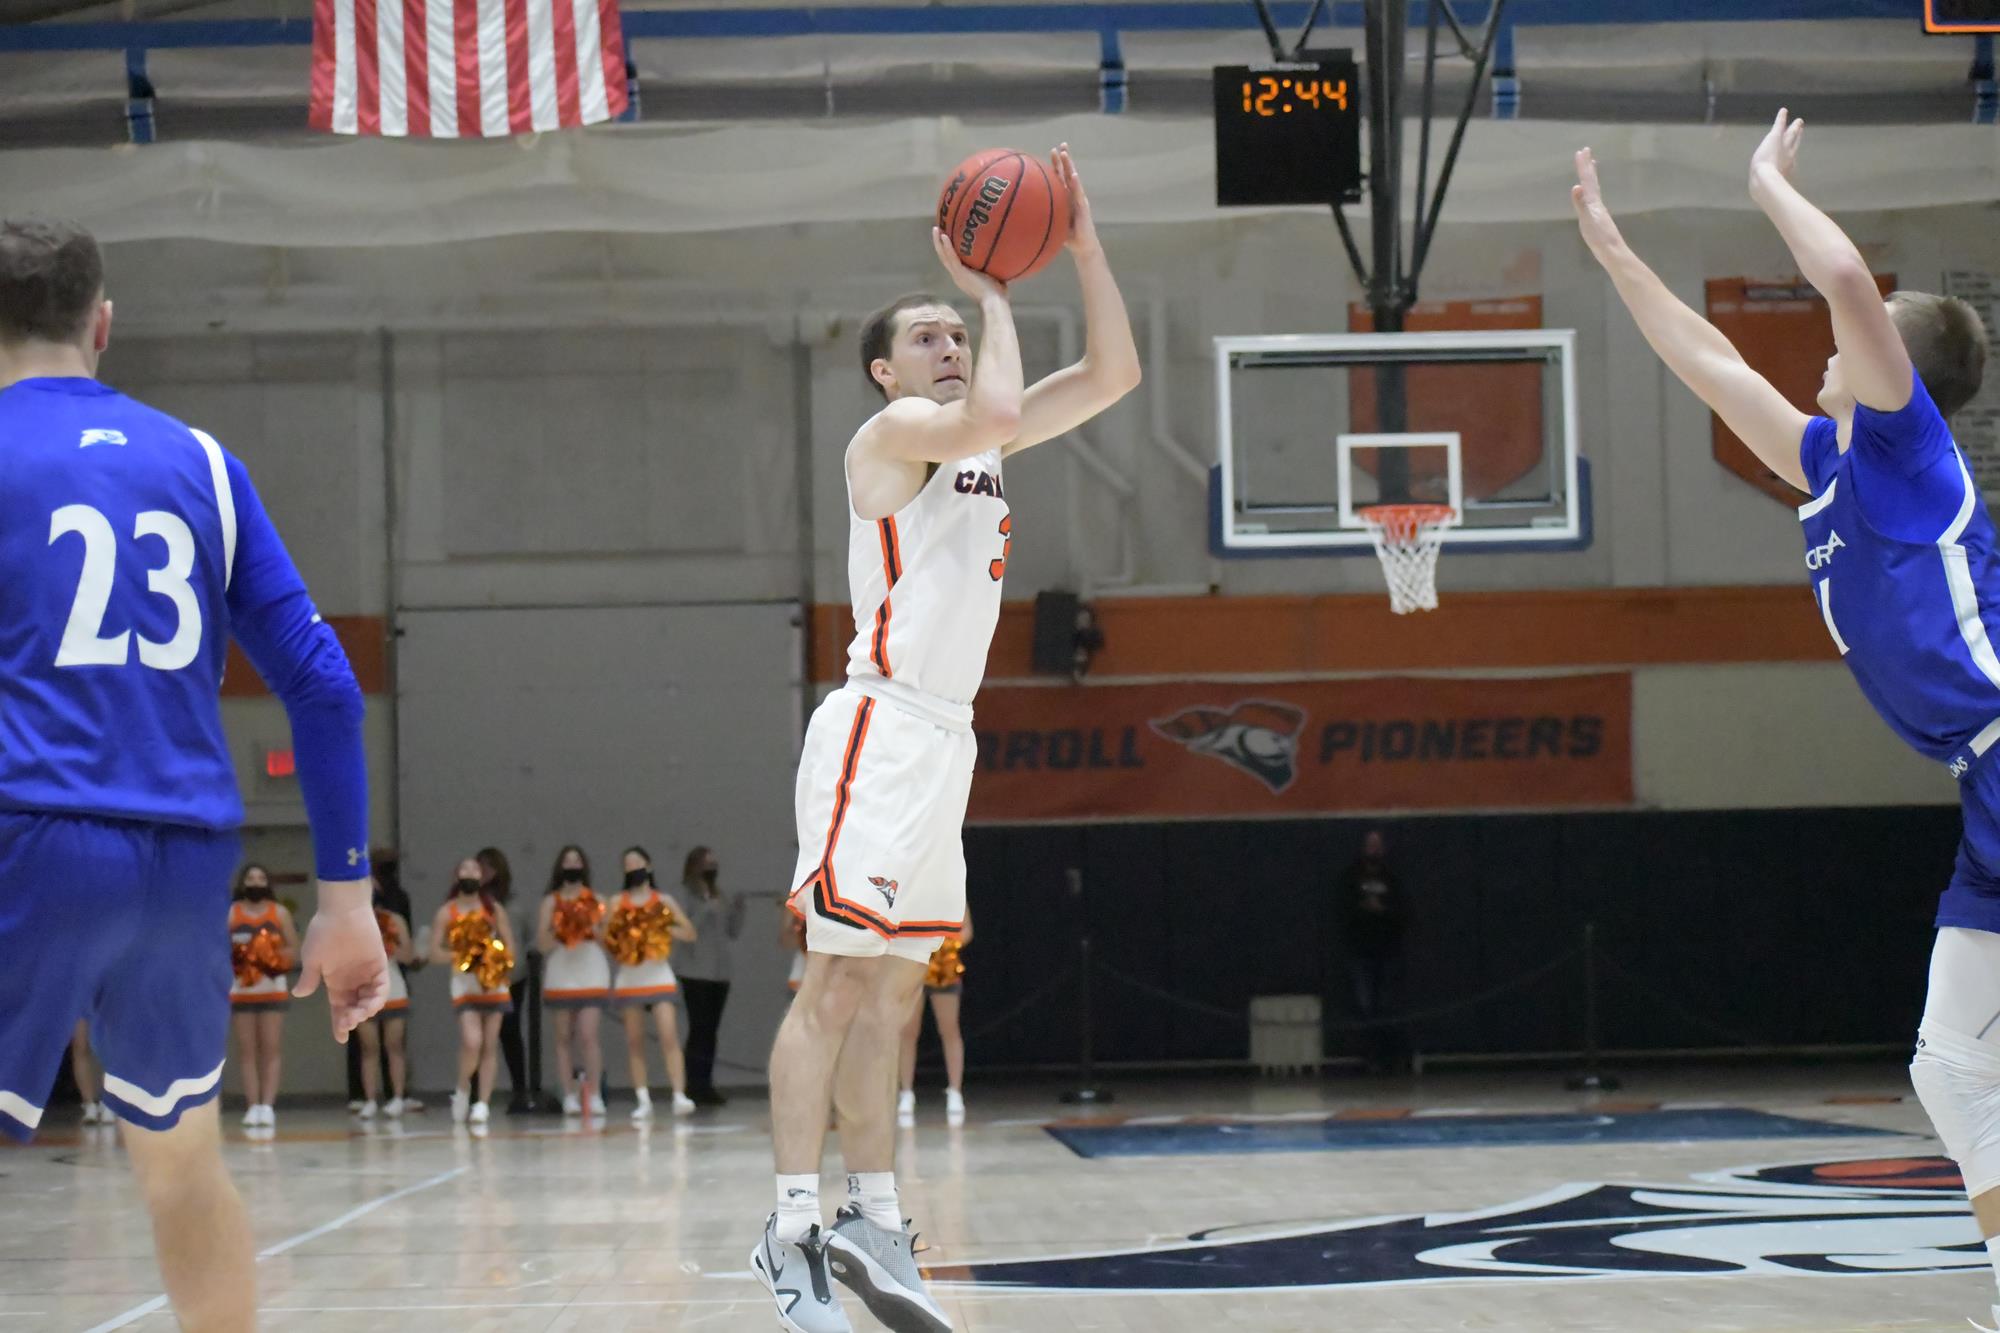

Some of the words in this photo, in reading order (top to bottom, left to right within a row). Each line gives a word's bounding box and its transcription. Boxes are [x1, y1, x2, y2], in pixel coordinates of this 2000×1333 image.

[1242, 76, 1348, 117] 12:44
[960, 175, 1011, 257] Wilson
[48, 504, 202, 671] 23
[1319, 715, 1604, 764] PIONEERS
